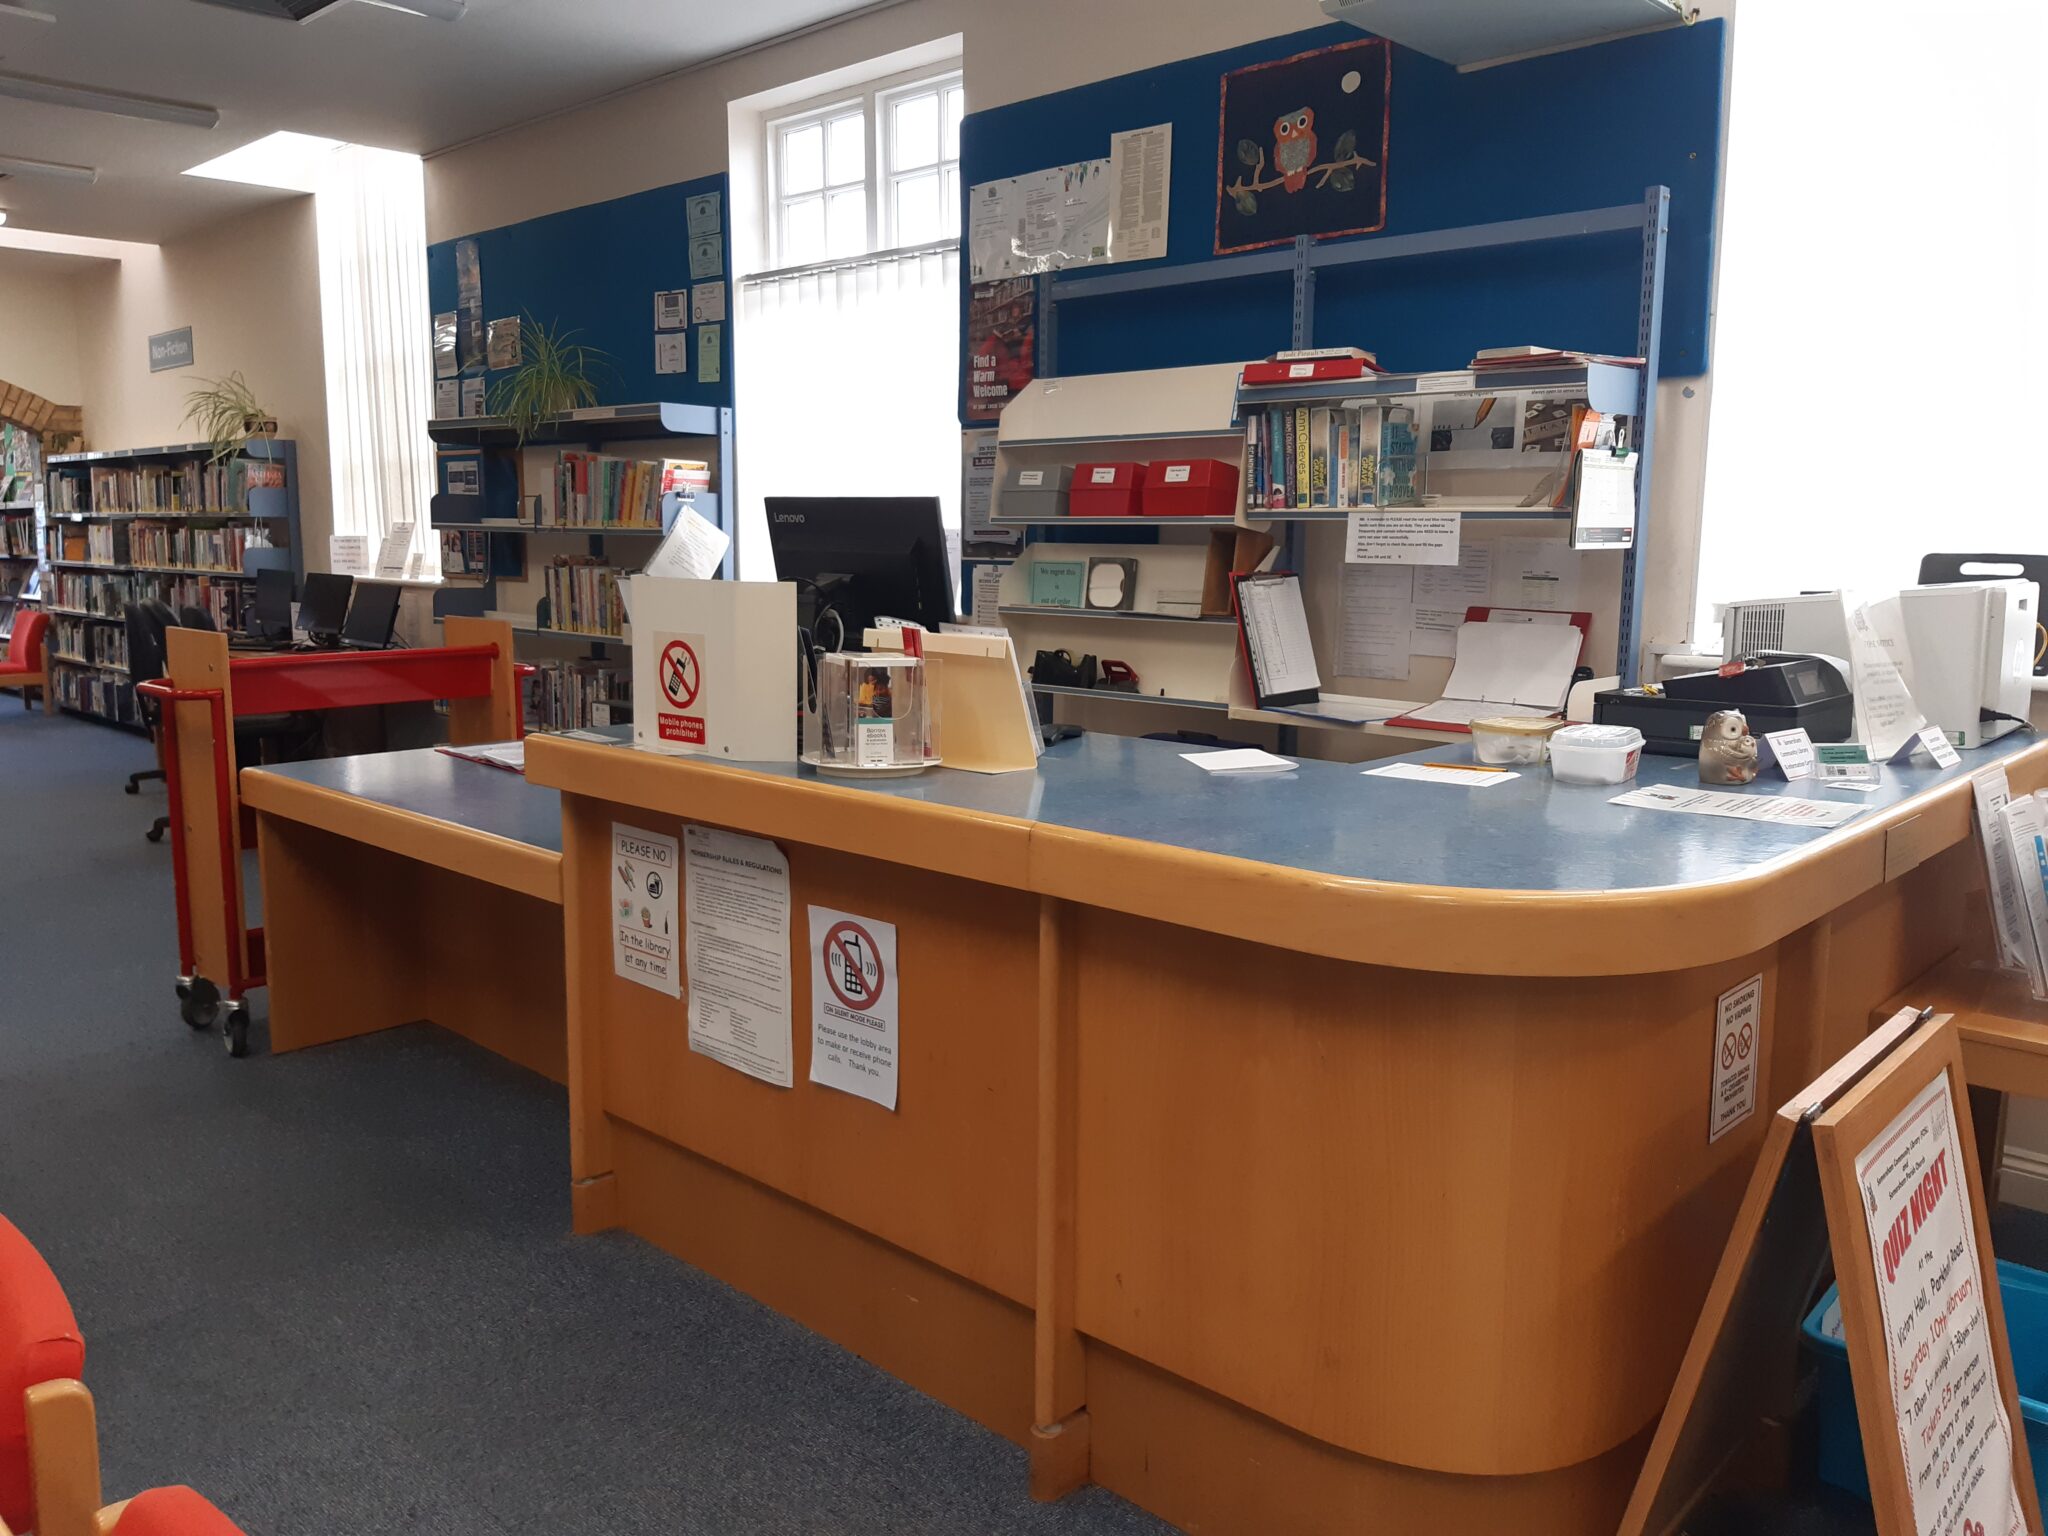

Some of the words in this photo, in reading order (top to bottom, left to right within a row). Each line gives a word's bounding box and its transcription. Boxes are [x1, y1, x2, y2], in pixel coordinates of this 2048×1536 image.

[152, 341, 188, 360] Non-Fiction
[973, 355, 990, 369] Find
[990, 355, 996, 367] a
[973, 370, 995, 383] Warm
[973, 384, 1008, 398] Welcome
[1298, 410, 1307, 432] Ann
[1298, 432, 1308, 475] Cleeves
[774, 511, 806, 524] Lenovo
[1050, 569, 1065, 577] regret
[659, 716, 680, 727] Mobile
[680, 719, 704, 730] phones
[665, 727, 698, 739] prohibited
[621, 839, 651, 859] PLEASE
[652, 847, 667, 863] NO
[690, 849, 721, 860] MEMBERSHIP
[722, 855, 740, 865] RULES
[744, 861, 783, 875] REGULATIONS
[619, 930, 629, 943] In
[630, 933, 643, 947] the
[644, 936, 671, 959] library
[624, 953, 633, 963] at
[635, 957, 648, 972] any
[649, 959, 667, 976] time
[1724, 1000, 1733, 1014] NO
[1732, 988, 1756, 1010] SMOKING
[825, 1005, 834, 1013] ON
[834, 1008, 850, 1018] SILENT
[850, 1013, 866, 1022] MODE
[866, 1018, 884, 1029] PLEASE
[1725, 1013, 1734, 1027] NO
[1733, 1003, 1753, 1022] VAPING
[818, 1023, 837, 1037] Please
[837, 1031, 848, 1040] use
[848, 1034, 860, 1044] the
[860, 1037, 877, 1051] lobby
[878, 1044, 892, 1055] area
[817, 1037, 824, 1045] to
[824, 1039, 841, 1051] make
[841, 1045, 849, 1053] or
[849, 1048, 872, 1061] receive
[872, 1055, 892, 1068] phone
[827, 1053, 842, 1064] calls.
[847, 1058, 867, 1073] Thank
[867, 1065, 881, 1077] you.
[1719, 1071, 1738, 1089] TOBACCO
[1719, 1105, 1736, 1123] THANK
[1877, 1164, 1894, 1187] Somersham
[1893, 1146, 1910, 1167] Community
[1909, 1137, 1920, 1150] Library
[1889, 1177, 1906, 1200] Somersham
[1906, 1165, 1916, 1181] Parish
[1915, 1156, 1925, 1171] Church
[1883, 1204, 1912, 1285] QUIZ
[1910, 1148, 1949, 1235] NIGHT
[1925, 1249, 1934, 1266] the
[1897, 1310, 1915, 1348] Victory
[1914, 1286, 1931, 1317] Hall,
[1930, 1255, 1952, 1297] Parkhall
[1950, 1235, 1964, 1262] Road
[1903, 1336, 1930, 1391] Saturday
[1930, 1310, 1948, 1343] 10th
[1946, 1274, 1973, 1316] ebruary
[1905, 1392, 1927, 1425] 7.00pm
[1921, 1405, 1942, 1448] Tickets
[1941, 1382, 1952, 1411] £5
[1953, 1377, 1962, 1399] per
[1963, 1353, 1979, 1386] person
[1918, 1462, 1932, 1490] from
[1931, 1446, 1940, 1469] the
[1939, 1420, 1954, 1450] library
[1954, 1408, 1961, 1424] or
[1961, 1394, 1970, 1413] the
[1970, 1369, 1987, 1400] church
[1936, 1473, 1942, 1489] or
[1942, 1458, 1950, 1479] £6
[1950, 1446, 1957, 1464] at
[1956, 1433, 1965, 1454] the
[1965, 1415, 1975, 1439] door
[1947, 1495, 1953, 1508] to
